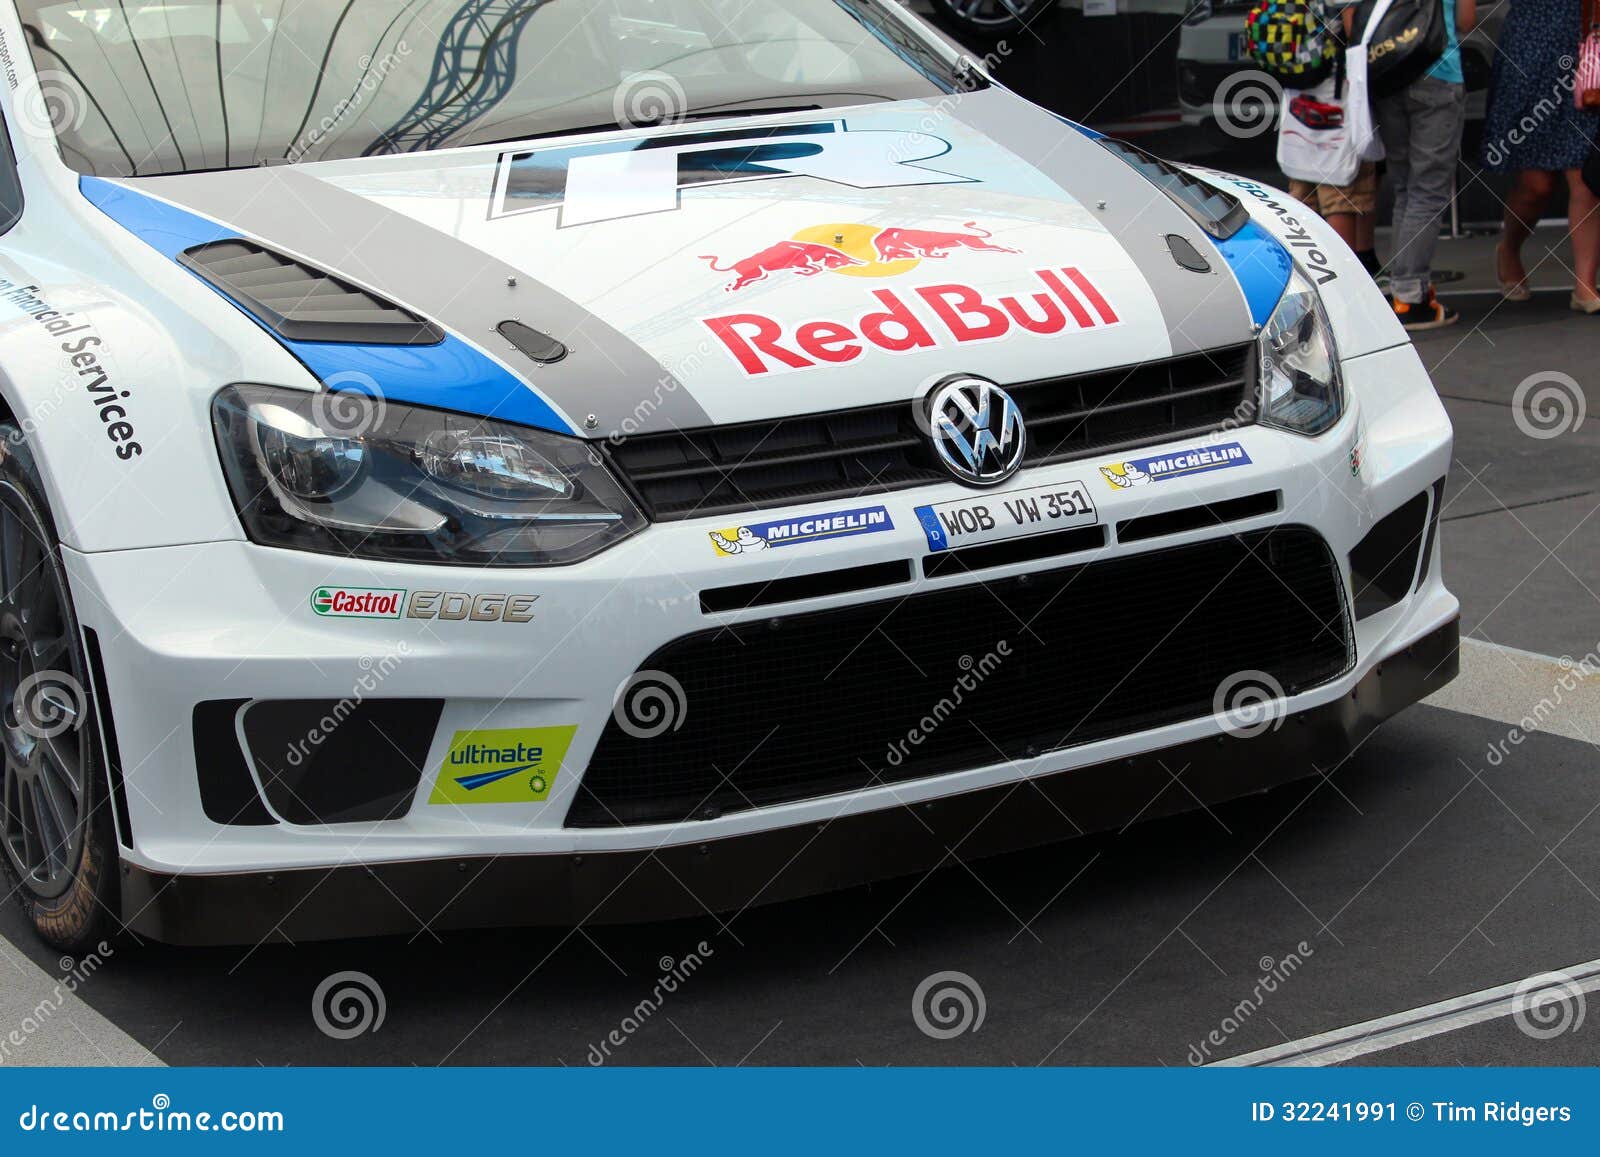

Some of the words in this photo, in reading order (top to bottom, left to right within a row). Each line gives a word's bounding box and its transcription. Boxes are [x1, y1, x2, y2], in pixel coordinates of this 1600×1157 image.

[702, 288, 937, 375] Red
[917, 267, 1121, 343] Bull
[4, 285, 91, 337] Financial
[61, 336, 143, 460] Services
[1149, 446, 1243, 474] MICHELIN
[767, 511, 886, 540] MICHELIN
[939, 505, 996, 537] WOB
[1004, 497, 1042, 525] VW
[1040, 490, 1093, 519] 351
[931, 530, 940, 541] D
[332, 590, 399, 614] Castrol
[406, 590, 540, 624] EDGE
[450, 742, 543, 765] ultimate
